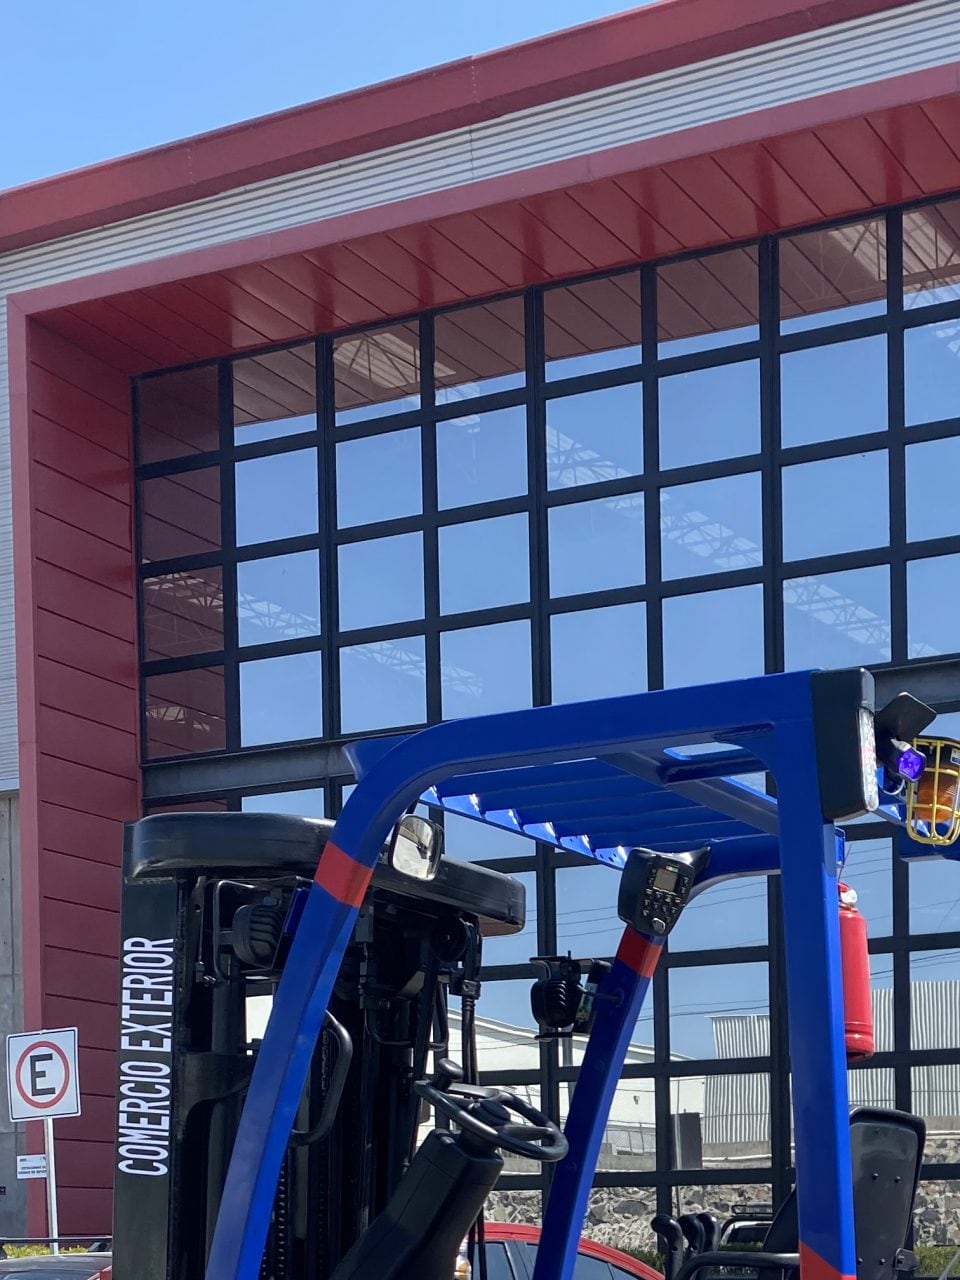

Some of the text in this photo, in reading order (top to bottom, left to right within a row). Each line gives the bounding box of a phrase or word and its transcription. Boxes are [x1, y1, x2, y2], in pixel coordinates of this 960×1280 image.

[29, 1053, 56, 1097] E
[118, 937, 174, 1176] COMERCIO EXTERIOR
